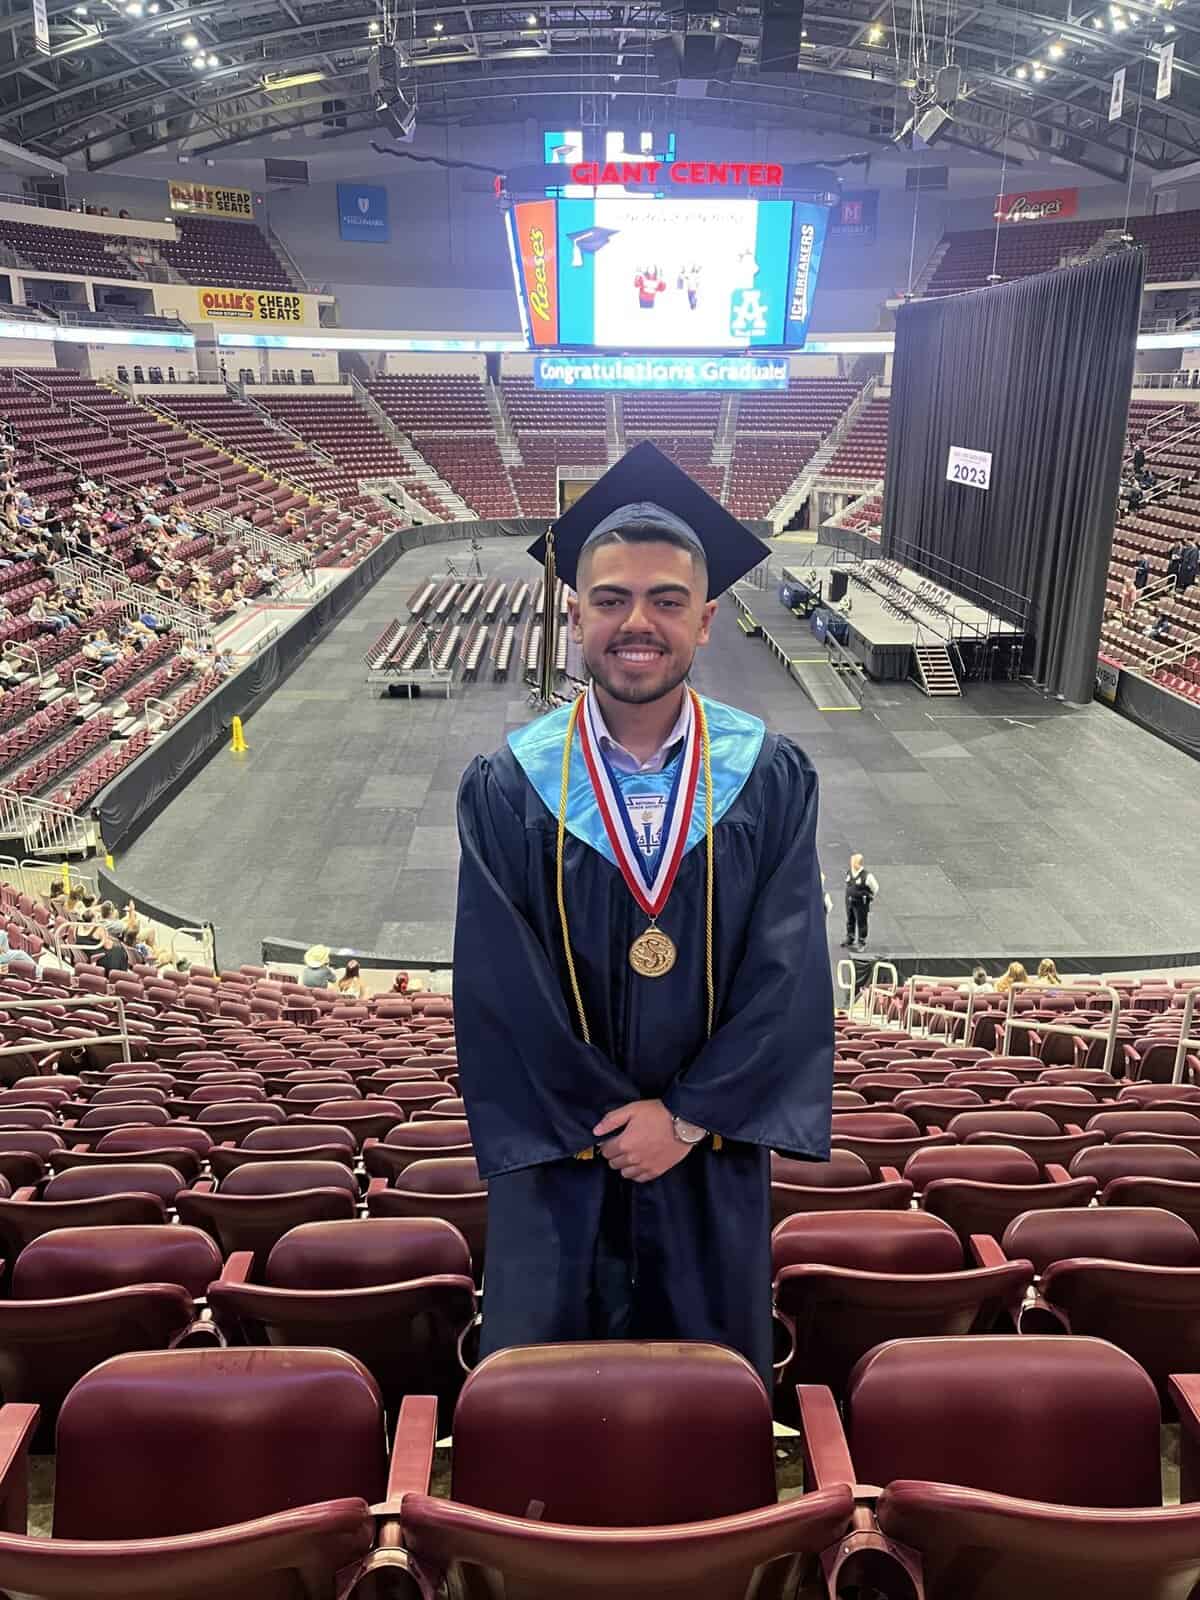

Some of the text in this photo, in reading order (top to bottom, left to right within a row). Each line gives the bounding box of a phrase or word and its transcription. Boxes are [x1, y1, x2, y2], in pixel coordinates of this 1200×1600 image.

[571, 162, 783, 185] GIANT CENTER
[215, 191, 250, 202] CHEAP
[216, 201, 250, 213] SEATS
[795, 224, 814, 296] BREAKERS
[530, 226, 551, 321] Reese's
[203, 293, 300, 311] OLLIE'S CHEAP
[260, 308, 300, 320] SEATS
[540, 361, 696, 385] Congratulations
[953, 464, 986, 485] 2023
